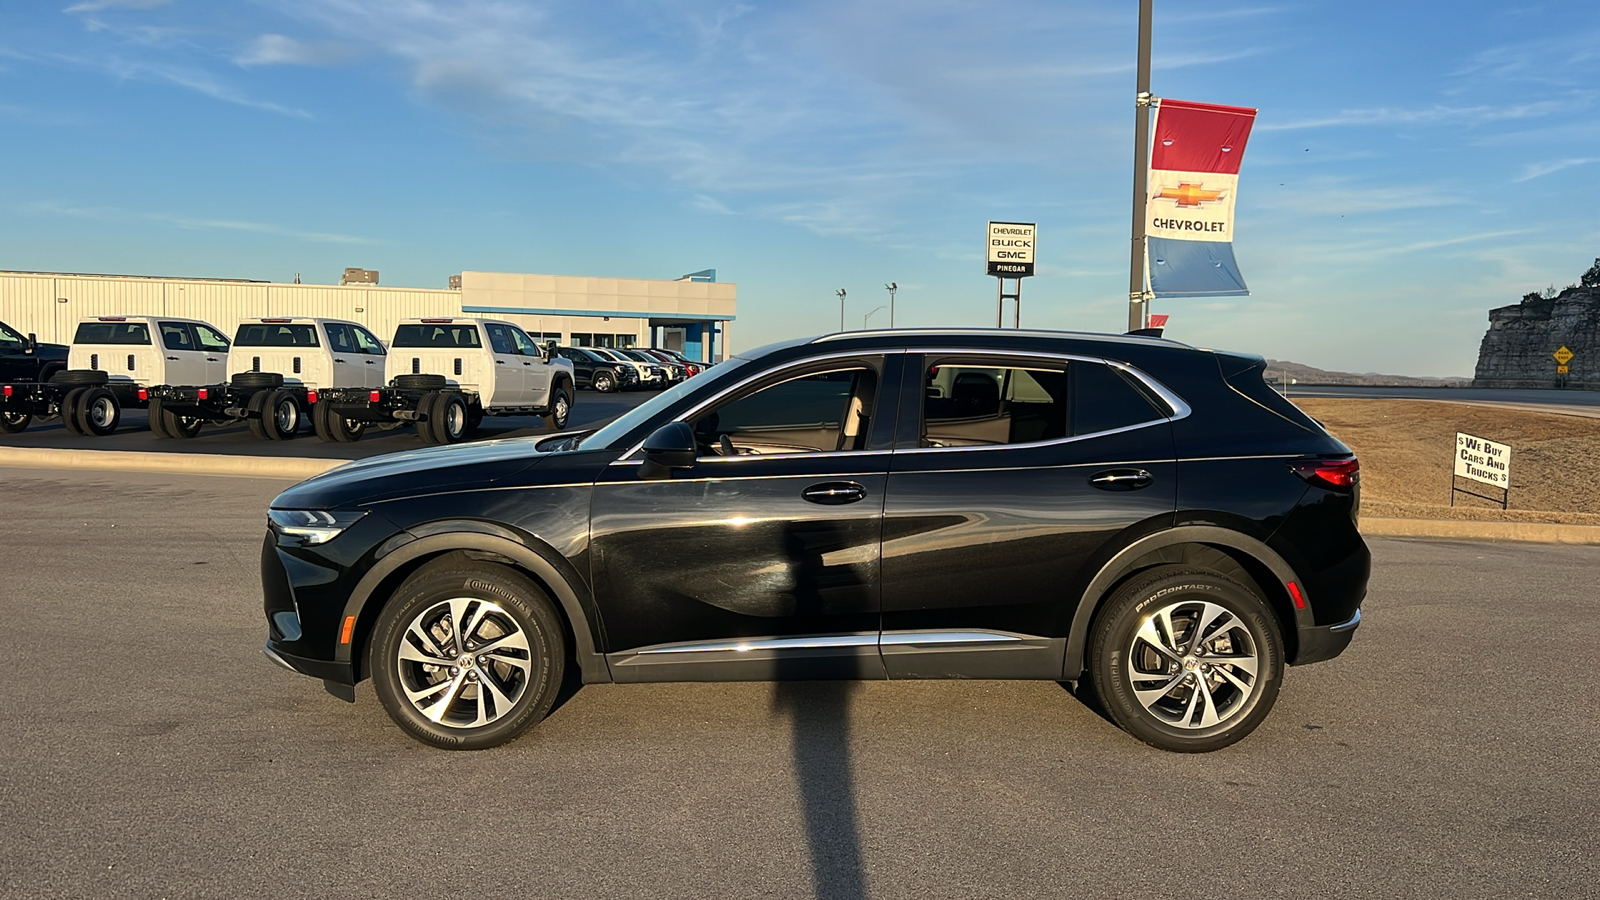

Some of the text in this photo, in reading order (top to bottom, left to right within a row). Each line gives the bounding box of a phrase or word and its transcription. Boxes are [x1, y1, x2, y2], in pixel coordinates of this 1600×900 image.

[1153, 217, 1225, 232] CHEVROLET
[992, 239, 1032, 247] BUICK
[997, 251, 1026, 259] GMC
